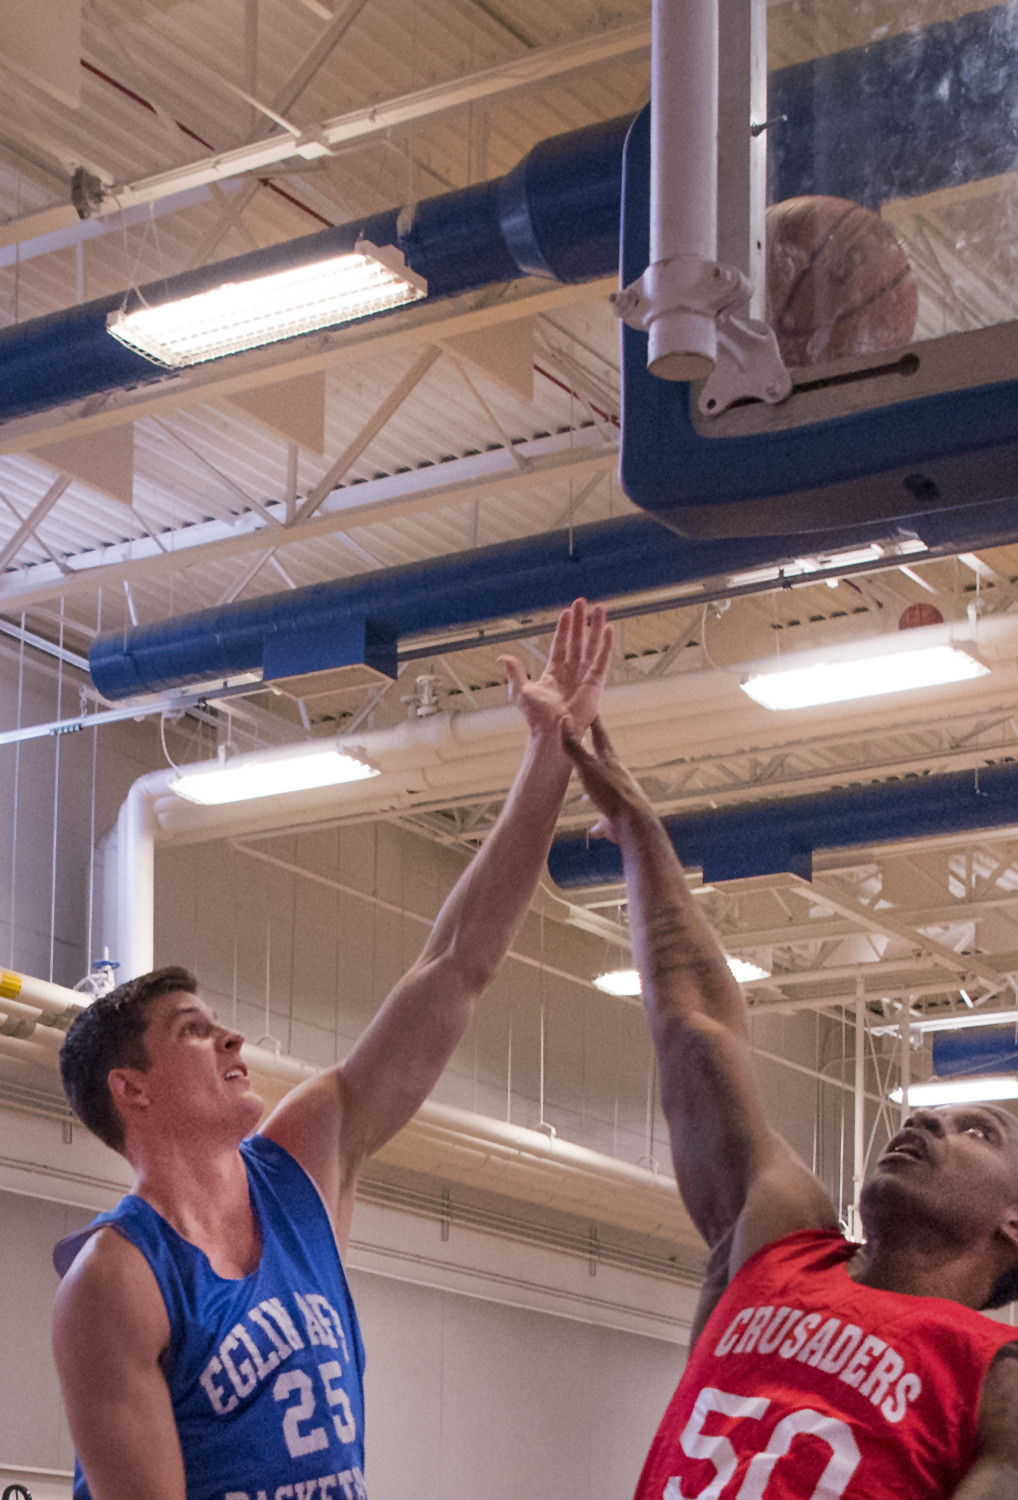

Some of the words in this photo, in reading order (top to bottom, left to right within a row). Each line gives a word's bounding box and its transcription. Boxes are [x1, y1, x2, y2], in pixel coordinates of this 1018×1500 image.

[200, 1297, 305, 1415] EGLIN
[273, 1361, 356, 1458] 25
[714, 1306, 922, 1423] CRUSADERS
